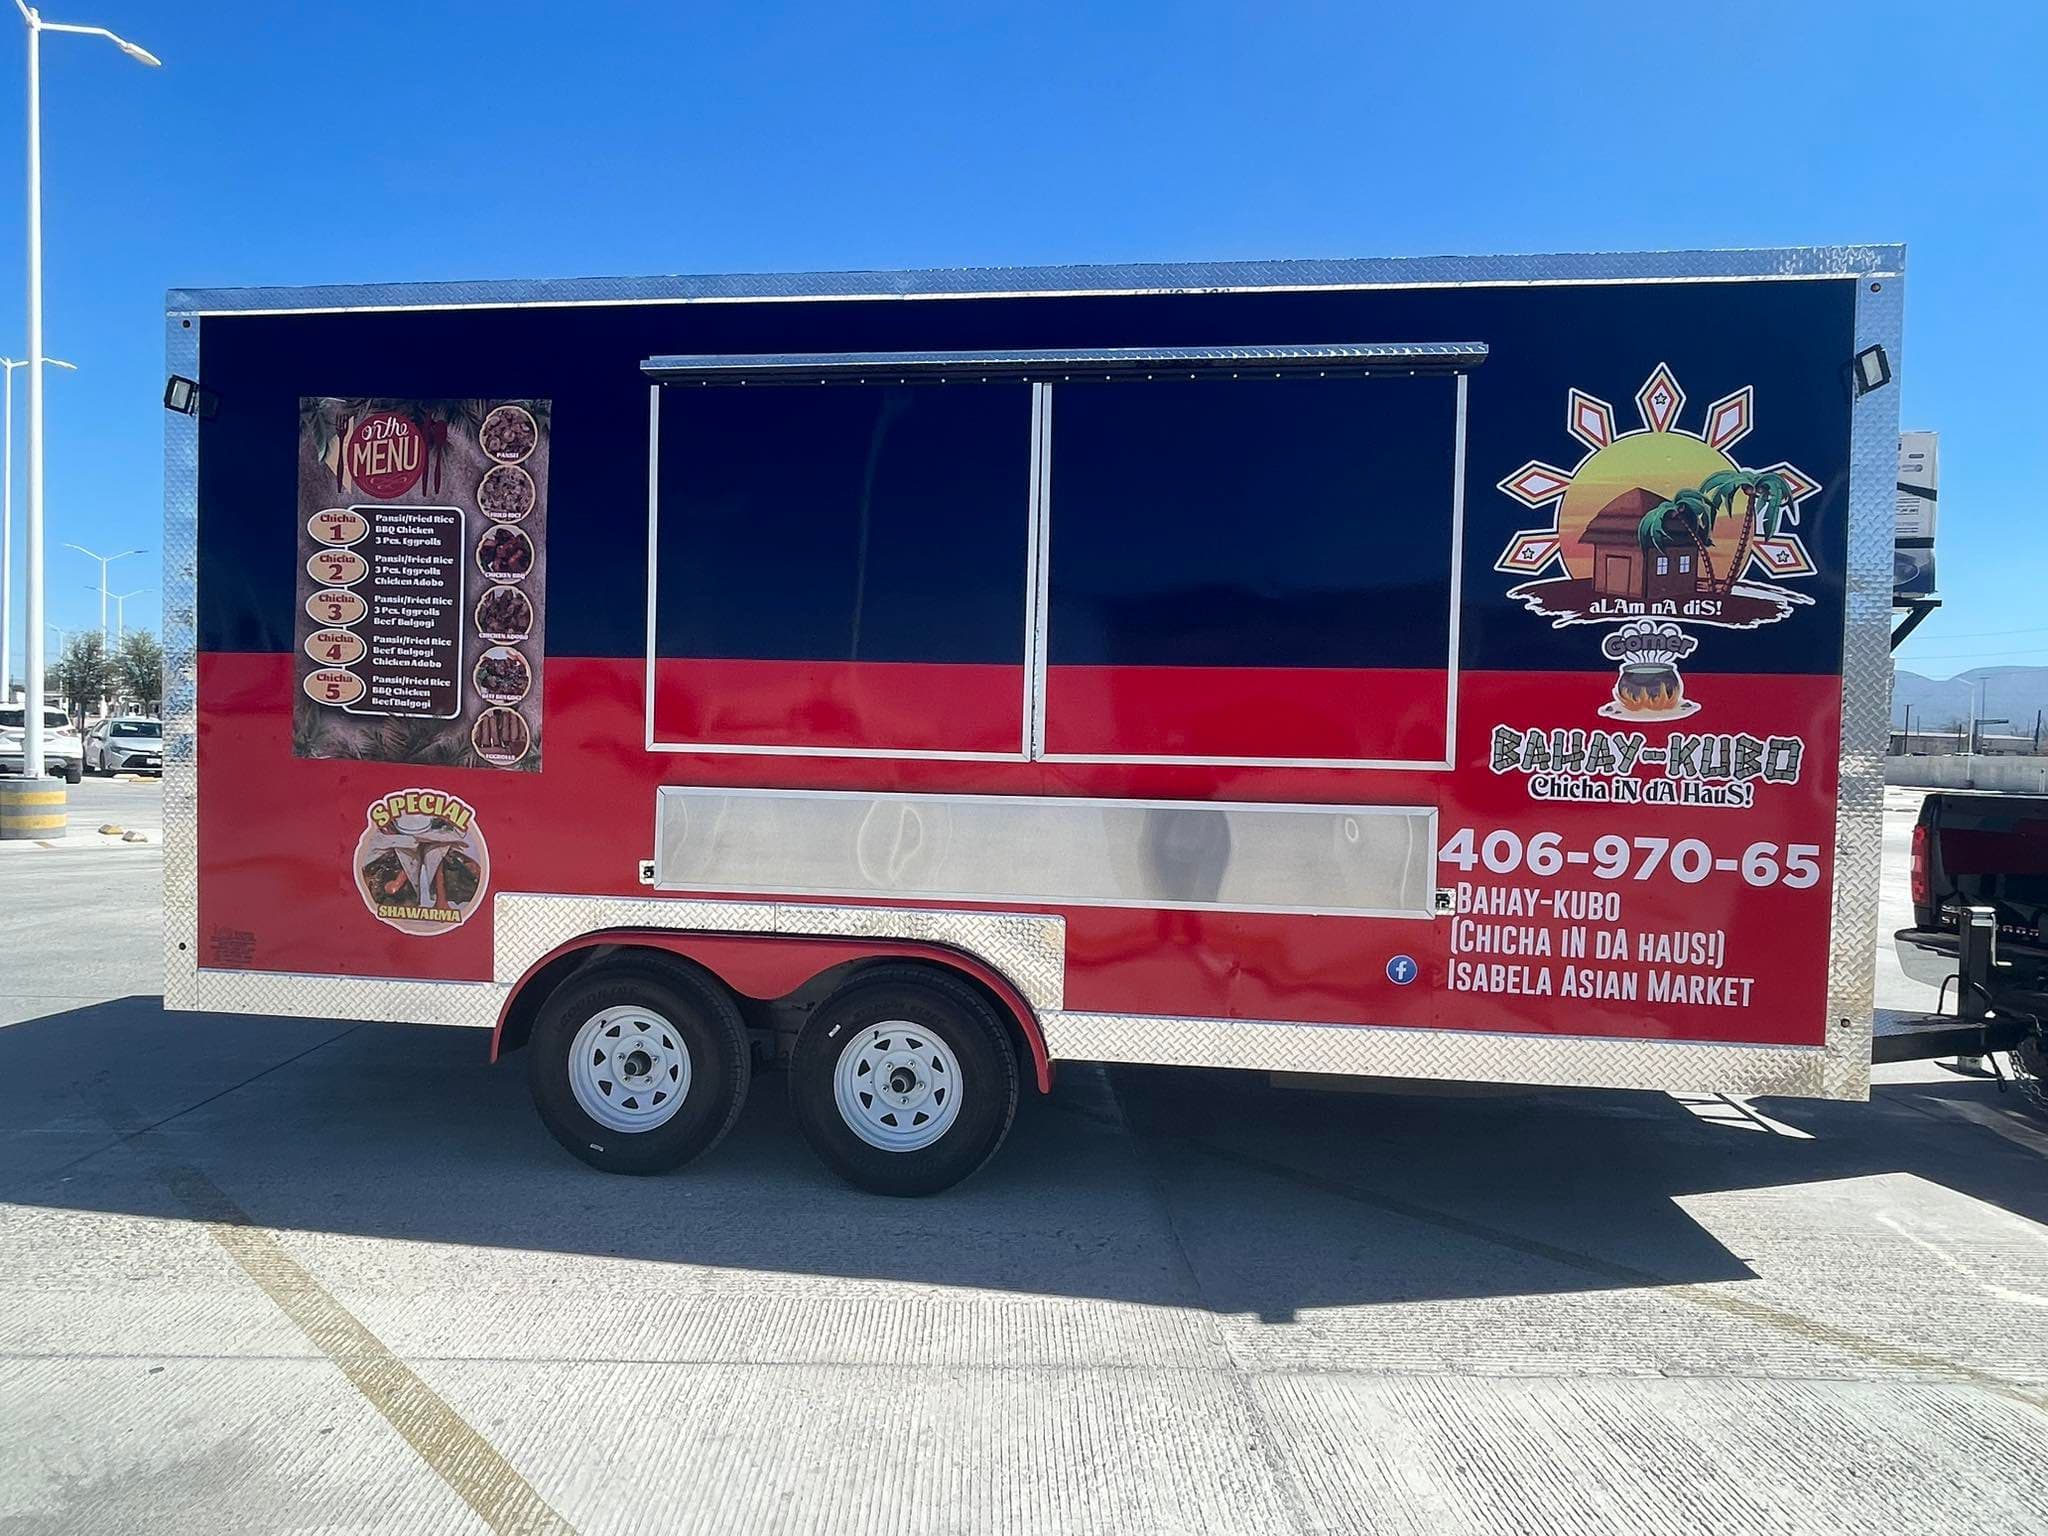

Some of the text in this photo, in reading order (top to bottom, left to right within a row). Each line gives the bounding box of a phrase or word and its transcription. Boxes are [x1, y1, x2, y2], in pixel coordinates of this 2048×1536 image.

[361, 416, 409, 440] on the
[353, 435, 419, 477] MENU
[320, 513, 357, 523] Chicha
[375, 513, 455, 524] Pansit/Fried Rice
[329, 524, 345, 541] 1
[375, 525, 435, 535] BBQ Chicken
[375, 536, 442, 547] 3 Pcs. Eggrolls
[319, 553, 356, 564] Chicha
[374, 554, 454, 565] Pansit/Fried Rice
[328, 563, 343, 580] 2
[374, 566, 441, 576] 3 Pcs. Eggrolls
[374, 576, 444, 587] Chicken Adobo
[318, 593, 355, 604] Chicha
[374, 594, 454, 606] Pansit/Fried Rice
[327, 603, 342, 621] 3
[373, 606, 440, 617] 3 Pcs. Eggrolls
[1588, 598, 1723, 616] aLAm nA diS!
[373, 617, 397, 626] Beef
[317, 633, 354, 643] Chicha
[373, 635, 453, 647] Pansit/Fried Rice
[325, 643, 342, 660] 4
[373, 646, 396, 655] Beef
[372, 657, 442, 668] Chicken Adobo
[316, 673, 353, 683] Chicha
[372, 675, 452, 687] Pansit/Fried Rice
[325, 683, 341, 700] 5
[372, 686, 431, 697] BBQ Chicken
[371, 697, 395, 706] Beef
[1493, 726, 1803, 781] BAHAY-KUBO
[1530, 776, 1753, 807] Chicha iN dA HauS!
[371, 793, 472, 830] SPECIAL
[1438, 827, 1821, 890] 406-970-65
[1456, 881, 1621, 923] BAHAY-KUBO
[378, 905, 462, 922] SHAWARMA
[1447, 957, 1755, 1008] ISABELA ASIAN MARKET
